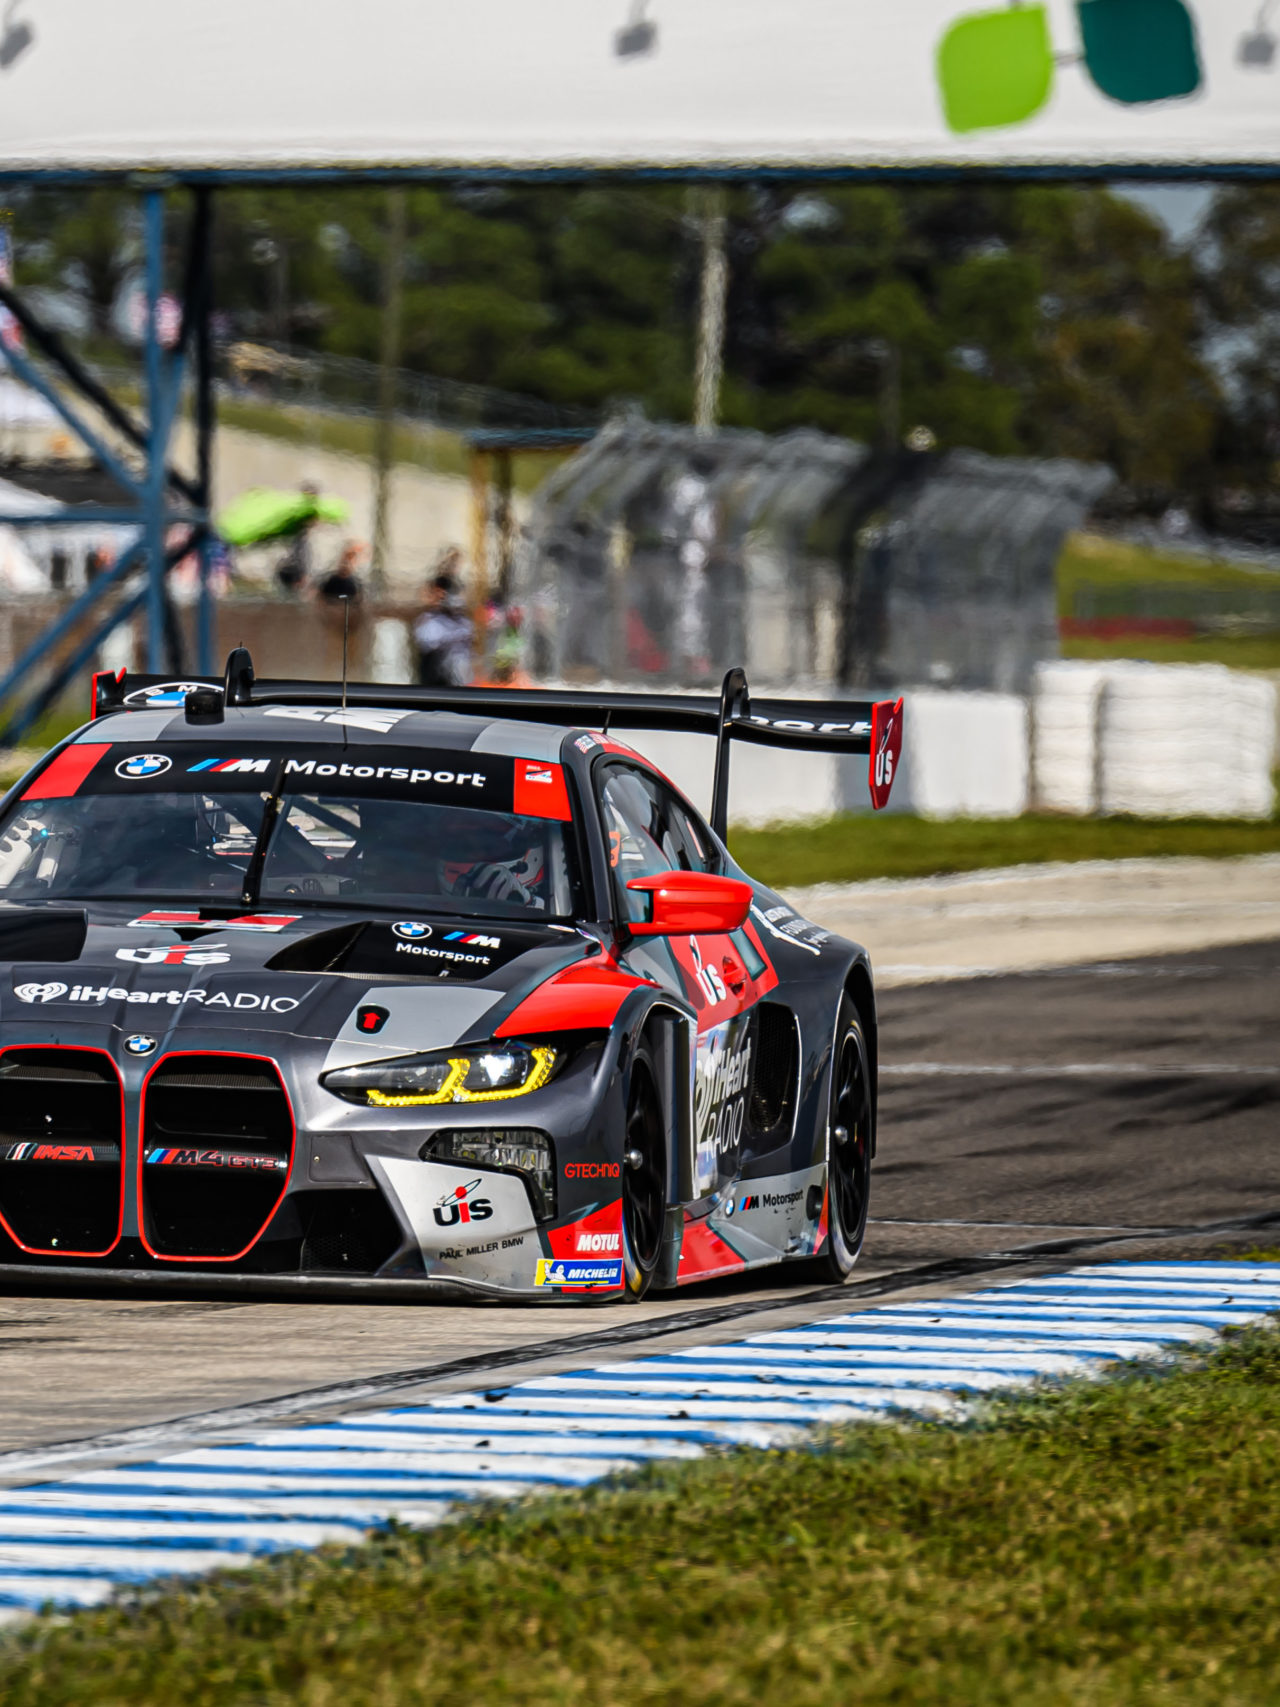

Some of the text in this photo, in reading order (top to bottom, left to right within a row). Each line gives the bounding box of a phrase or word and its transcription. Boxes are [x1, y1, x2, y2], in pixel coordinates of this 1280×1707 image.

[285, 759, 487, 788] Motorsport
[395, 942, 491, 965] Motorsport
[705, 1097, 745, 1163] RADIO
[33, 1144, 95, 1161] IMSA
[171, 1149, 279, 1170] M4 GT3
[763, 1189, 803, 1208] Motorsport
[439, 1236, 524, 1260] PAUL MILLER BMW
[576, 1234, 620, 1251] MOTUL
[567, 1267, 618, 1279] MICHELIN
